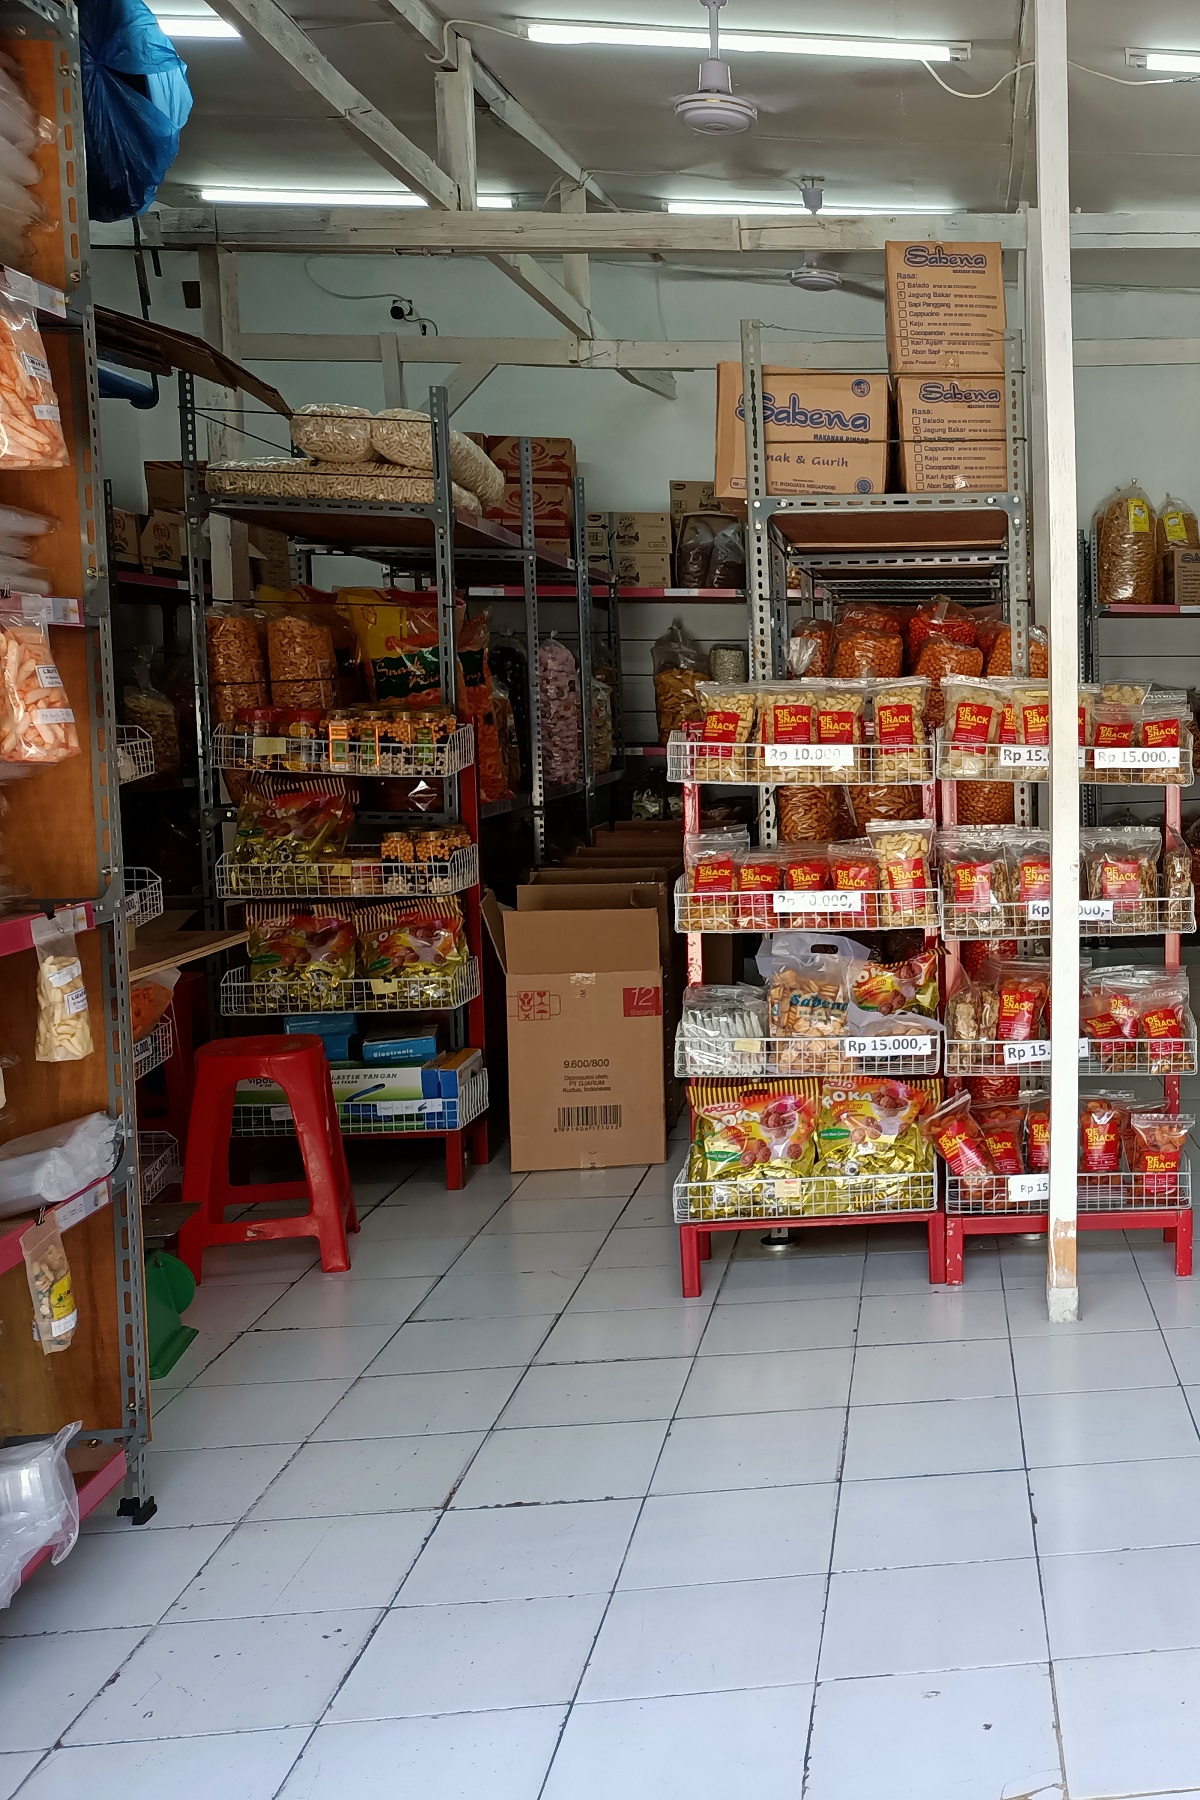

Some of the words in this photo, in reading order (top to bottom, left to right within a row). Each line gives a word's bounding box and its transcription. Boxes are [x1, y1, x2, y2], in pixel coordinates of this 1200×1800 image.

[904, 245, 987, 268] Sabena
[896, 272, 918, 280] Rasa:
[909, 320, 924, 328] Keju
[919, 381, 1001, 403] Sabena
[735, 392, 871, 433] Sabena
[813, 434, 843, 442] MAKANAN
[795, 455, 805, 464] &
[812, 456, 849, 468] Gurih
[775, 708, 790, 717] DE
[878, 708, 892, 717] DE
[958, 706, 972, 715] DE
[1024, 709, 1039, 717] DE
[707, 715, 718, 723] DE
[777, 715, 809, 724] SNACK
[819, 715, 833, 724] DE
[878, 714, 910, 724] SNACK
[959, 713, 988, 725] SNACK
[706, 722, 735, 731] SNACK
[820, 722, 851, 731] SNACK
[1145, 724, 1159, 732] DE
[1099, 731, 1129, 739] SNACK
[1147, 727, 1177, 737] SNACK
[1003, 749, 1022, 763] Rp
[1098, 751, 1116, 764] Rp
[1121, 751, 1176, 765] 15.000,-
[698, 864, 712, 873] DE
[699, 868, 731, 877] SNACK
[740, 866, 754, 875] DE
[789, 867, 804, 876] DE
[889, 865, 903, 875] DE
[957, 868, 971, 877] DE
[1023, 865, 1038, 874] DE
[1104, 866, 1116, 874] DE
[742, 874, 772, 883] SNACK
[837, 869, 849, 879] DE
[892, 869, 923, 880] SNACK
[1106, 872, 1137, 881] SNACK
[837, 877, 867, 887] SNACK
[959, 875, 989, 883] SNACK
[1032, 904, 1049, 917] Rp
[631, 987, 655, 1006] 12
[1002, 994, 1015, 1003] DE
[1003, 1001, 1031, 1011] SNACK
[1110, 998, 1122, 1008] DE
[1145, 1014, 1158, 1023] DE
[1092, 1019, 1117, 1030] SNACK
[1146, 1019, 1178, 1030] SNACK
[848, 1039, 867, 1053] Rp
[871, 1037, 928, 1052] 15.000,-
[373, 1048, 414, 1058] Electronic
[1007, 1046, 1026, 1060] Rp
[563, 1058, 610, 1069] 9.600/800
[362, 1072, 398, 1080] TANGAN
[822, 1091, 872, 1110] ROKA
[702, 1103, 741, 1114] APOLLO
[1033, 1124, 1044, 1133] DE
[1086, 1128, 1098, 1136] DE
[941, 1132, 969, 1152] SNACK
[1088, 1133, 1116, 1143] SNACK
[1146, 1155, 1160, 1164] DE
[1147, 1161, 1176, 1169] SNACK
[1020, 1184, 1033, 1193] Rp
